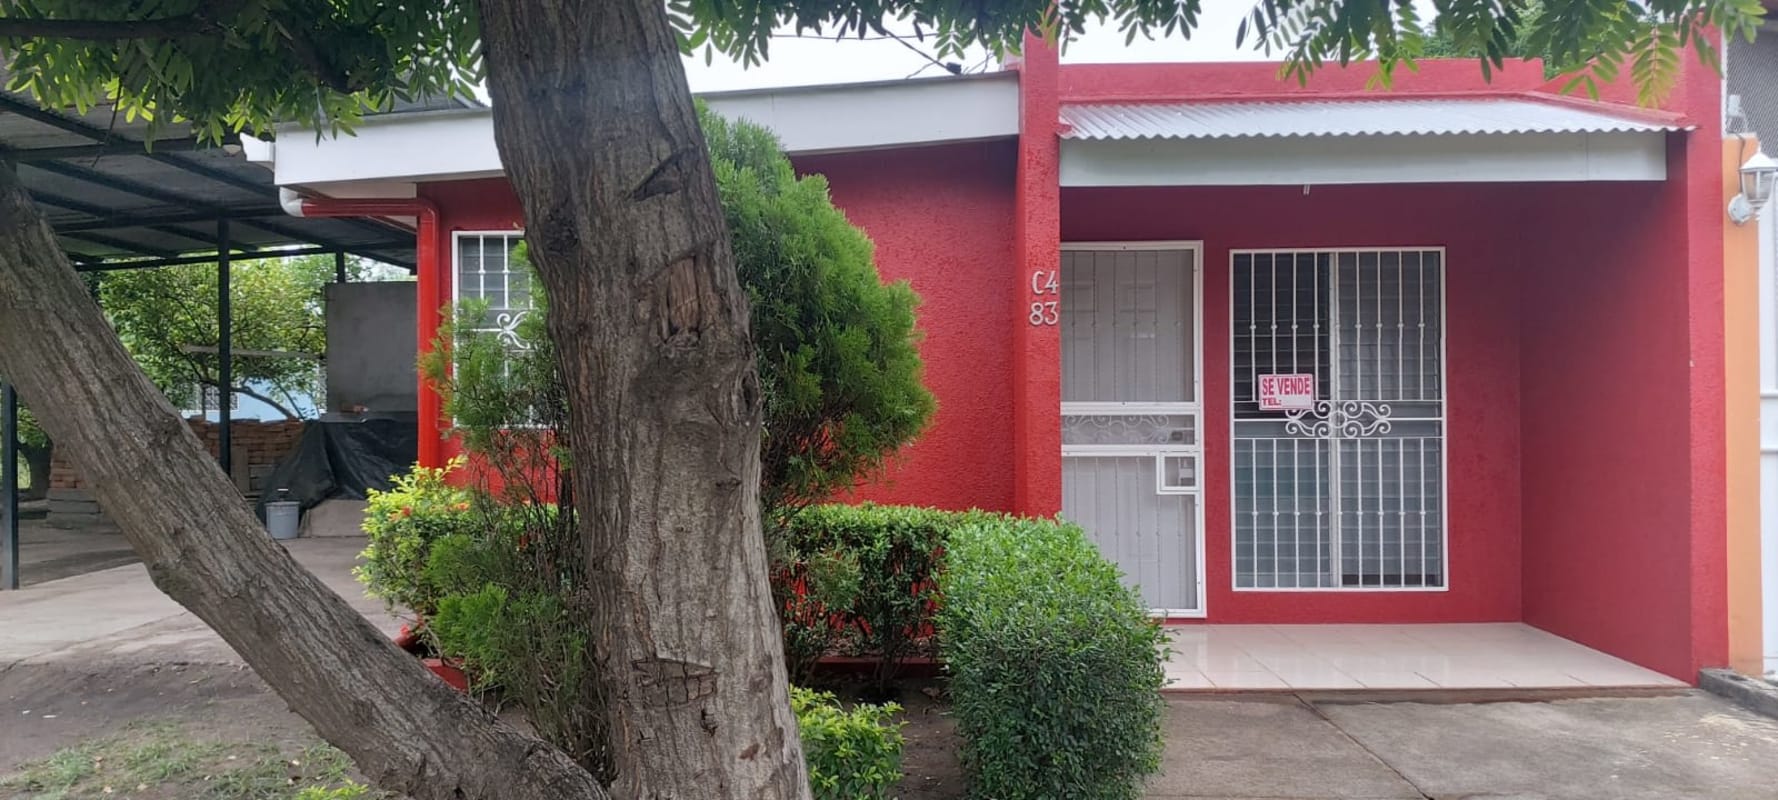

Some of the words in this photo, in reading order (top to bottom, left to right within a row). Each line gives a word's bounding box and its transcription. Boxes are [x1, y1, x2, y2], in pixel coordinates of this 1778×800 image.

[1032, 270, 1058, 295] C4
[1029, 301, 1058, 325] 83
[1262, 378, 1274, 395] SE
[1277, 377, 1310, 395] VENDE
